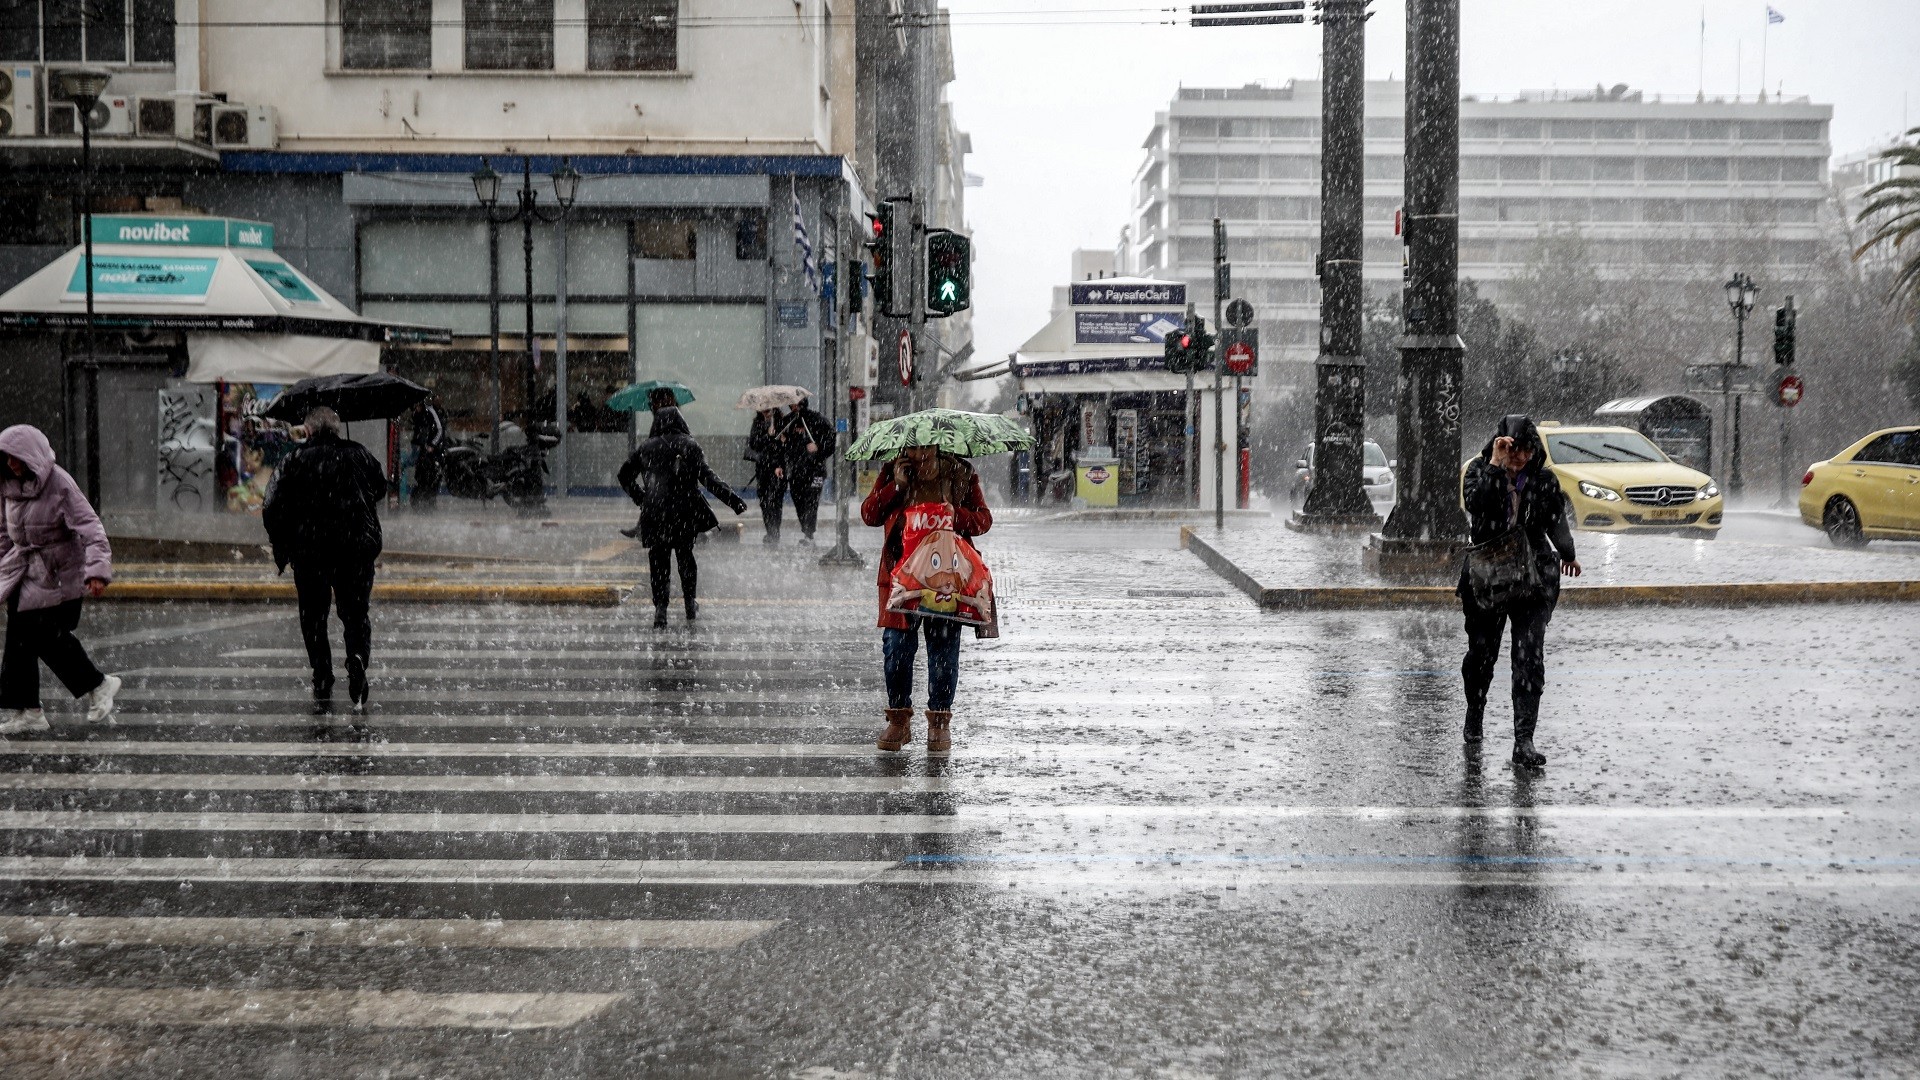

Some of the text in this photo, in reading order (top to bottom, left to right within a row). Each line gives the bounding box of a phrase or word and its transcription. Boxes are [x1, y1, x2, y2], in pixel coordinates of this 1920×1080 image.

[119, 222, 190, 242] novibet
[238, 227, 263, 245] novibet
[1105, 290, 1170, 302] PaysafeCard
